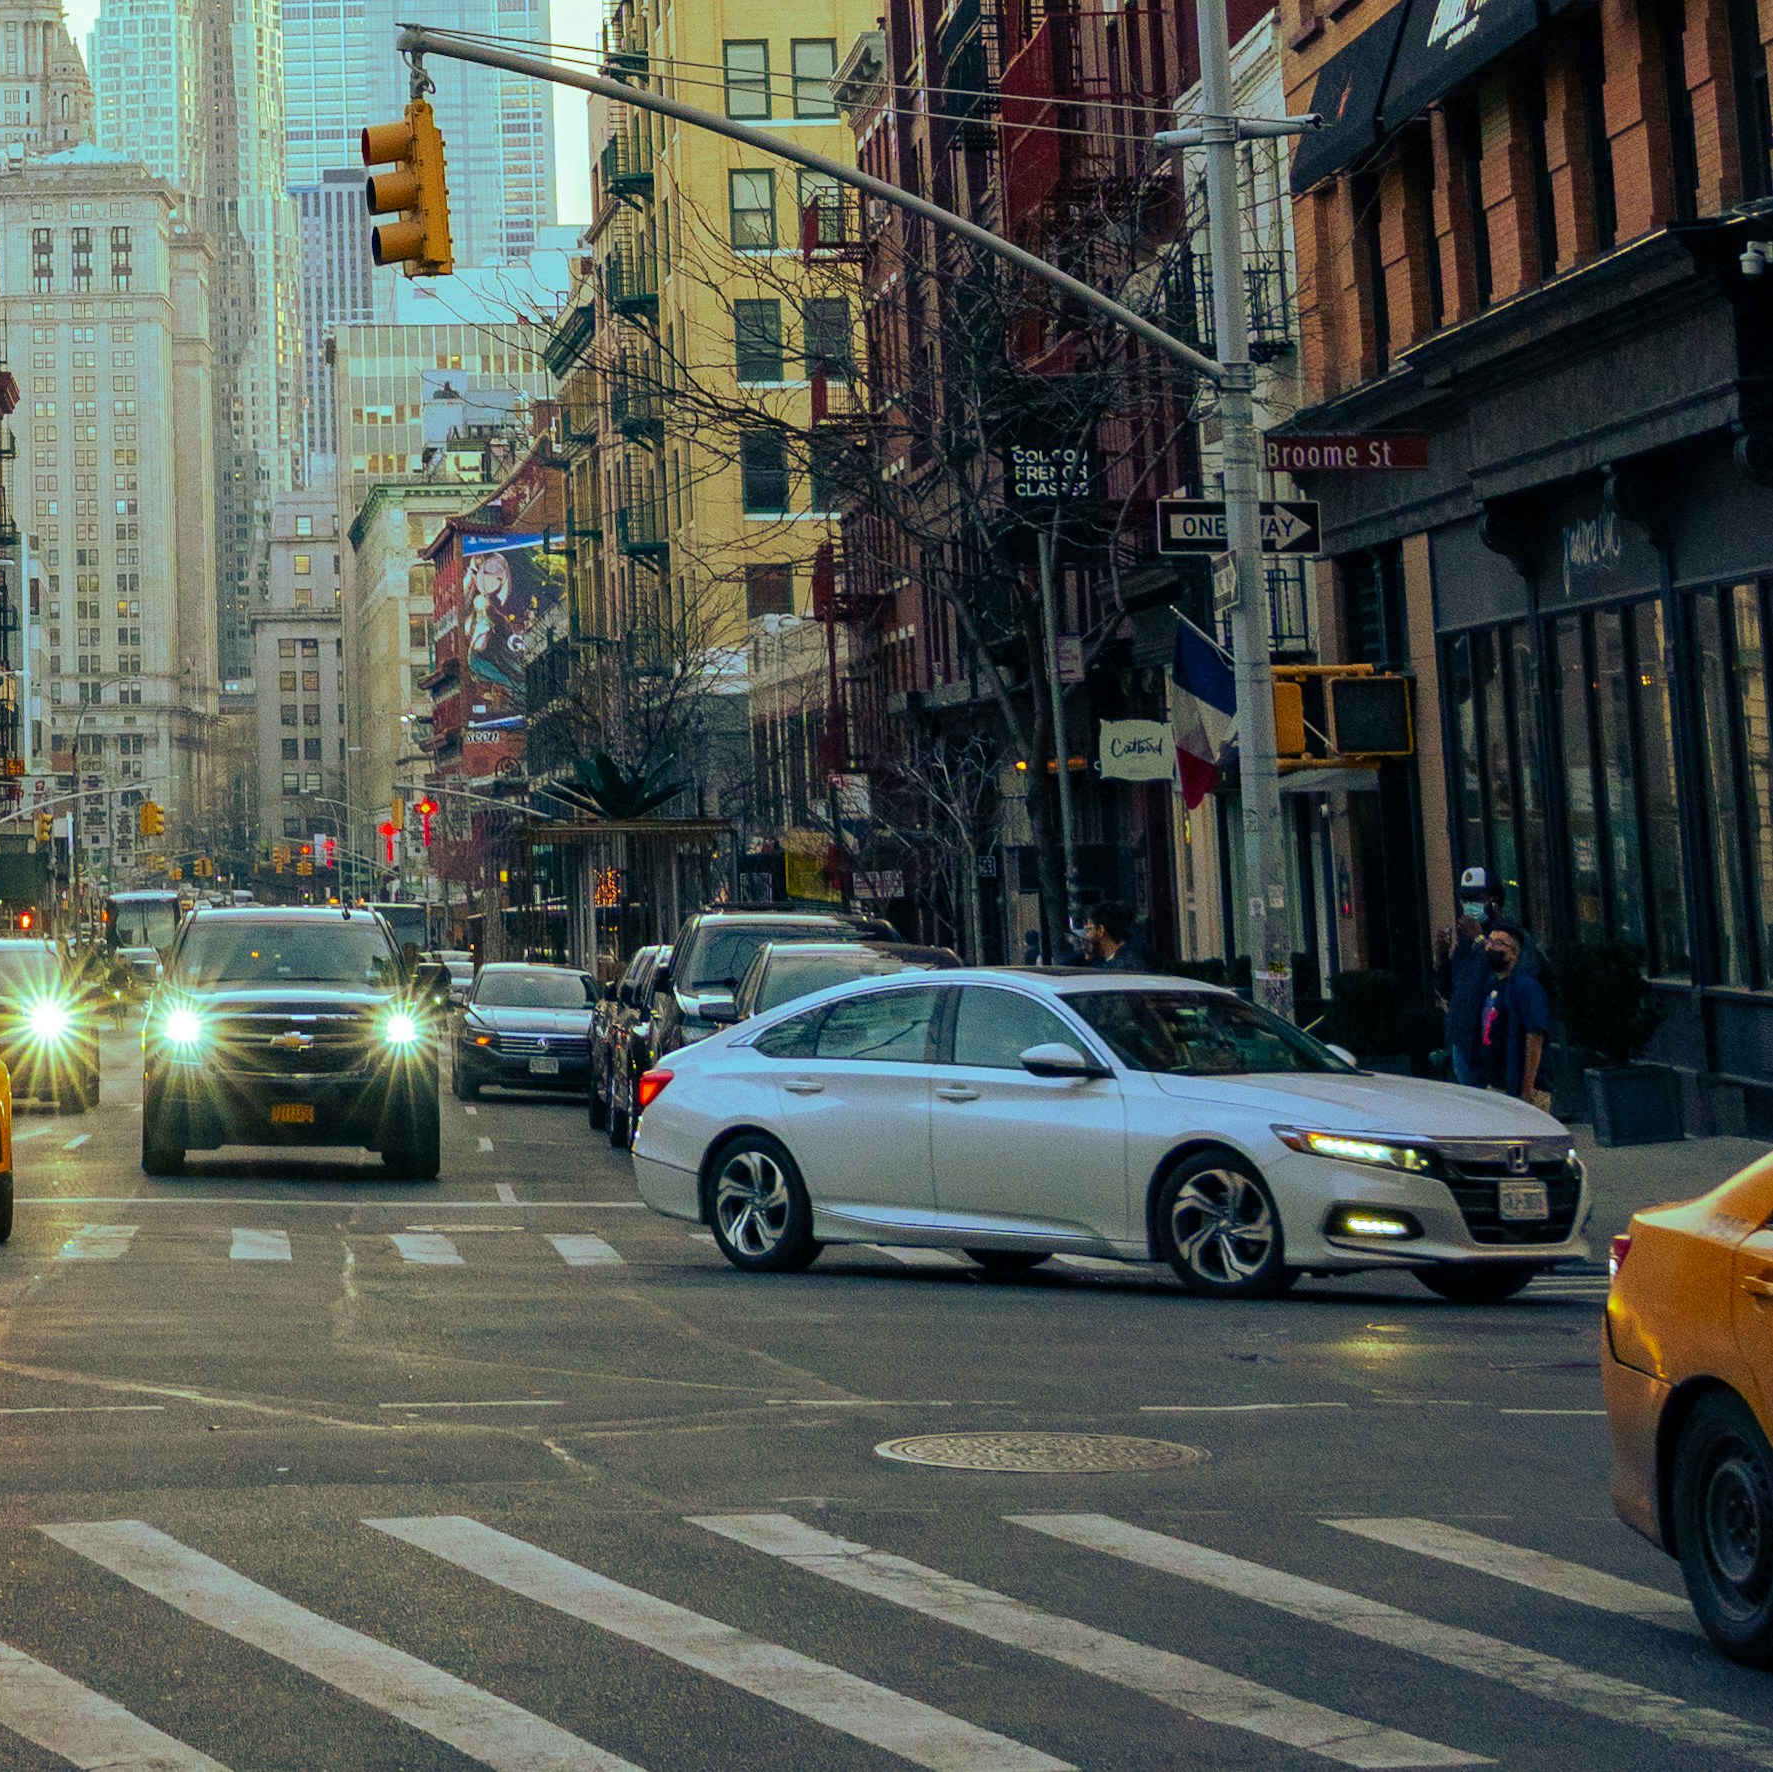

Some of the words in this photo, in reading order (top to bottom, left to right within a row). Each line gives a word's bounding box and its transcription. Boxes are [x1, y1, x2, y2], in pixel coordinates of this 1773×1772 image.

[1266, 442, 1358, 468] Broome
[1369, 441, 1392, 467] St
[1182, 516, 1227, 536] ONE
